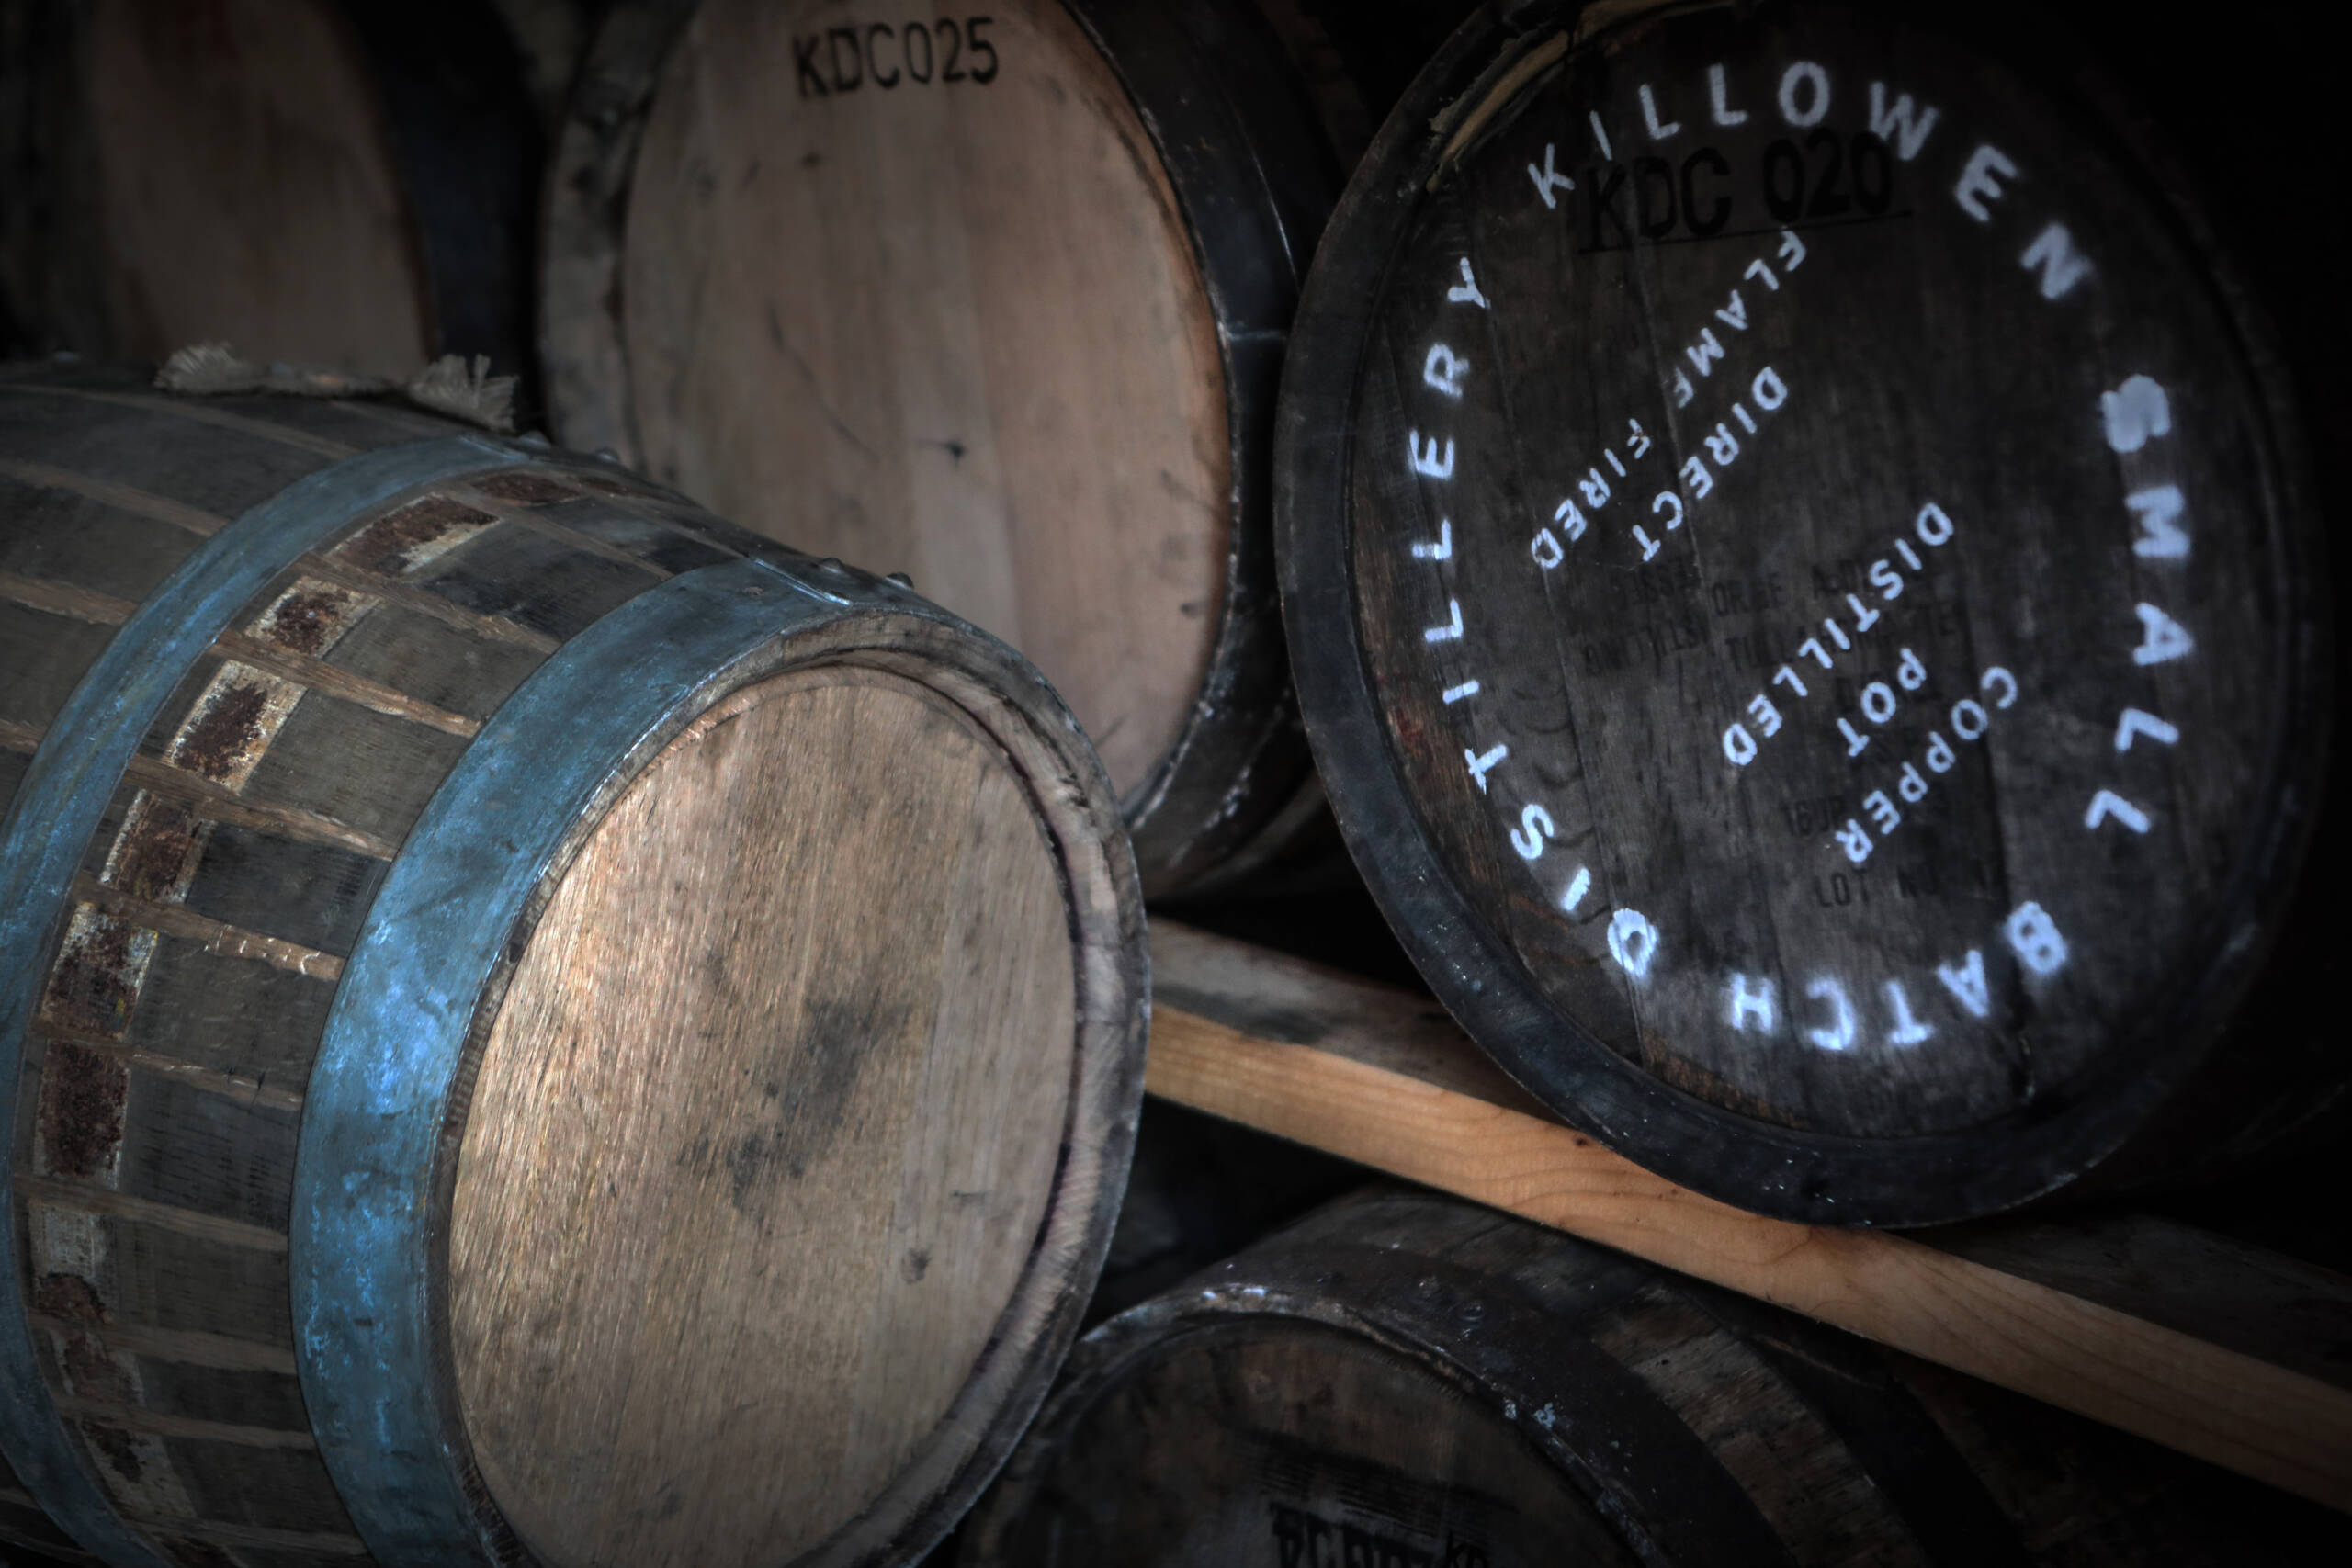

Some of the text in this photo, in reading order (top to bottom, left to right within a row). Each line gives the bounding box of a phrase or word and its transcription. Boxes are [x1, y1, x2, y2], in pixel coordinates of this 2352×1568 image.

[792, 17, 999, 97] KDC025
[1527, 61, 2091, 300] KILLOWEN
[1585, 126, 1894, 250] KDC 020
[1673, 227, 1807, 409] FLAME
[1530, 418, 1652, 570] FIRED
[1632, 366, 1789, 563] DIRECT
[1407, 254, 1660, 976] DISTILLERY
[1721, 502, 1955, 766] DISTILLED
[2083, 373, 2195, 835] SMALL
[1835, 664, 2019, 863] COPPER
[1837, 646, 1928, 759] POT
[1724, 899, 2070, 1054] BATCH
